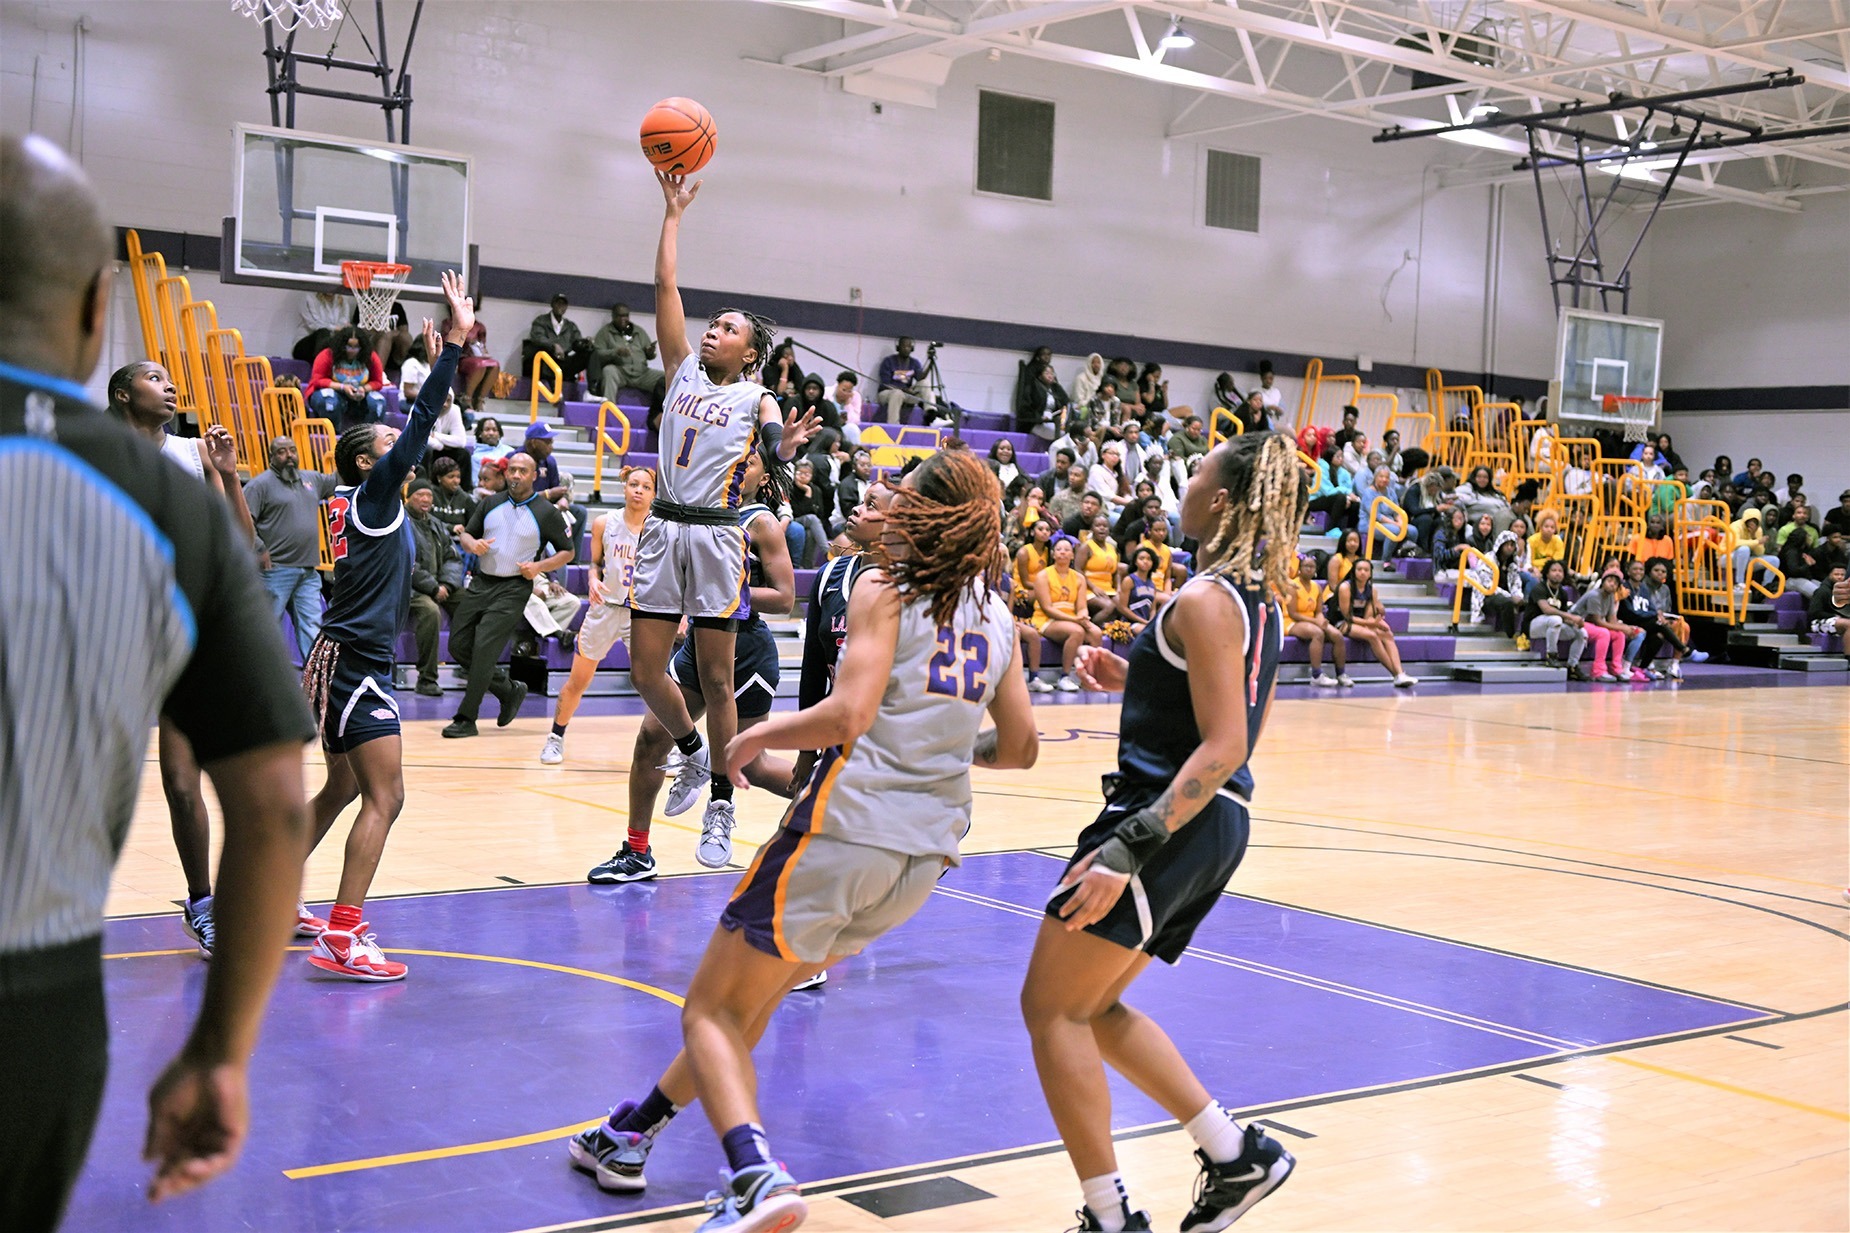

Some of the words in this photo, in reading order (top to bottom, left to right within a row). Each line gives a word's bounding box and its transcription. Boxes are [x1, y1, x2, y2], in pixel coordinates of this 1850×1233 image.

[670, 392, 733, 428] MILES
[675, 426, 699, 469] 1
[622, 564, 635, 587] 3
[926, 625, 991, 704] 22
